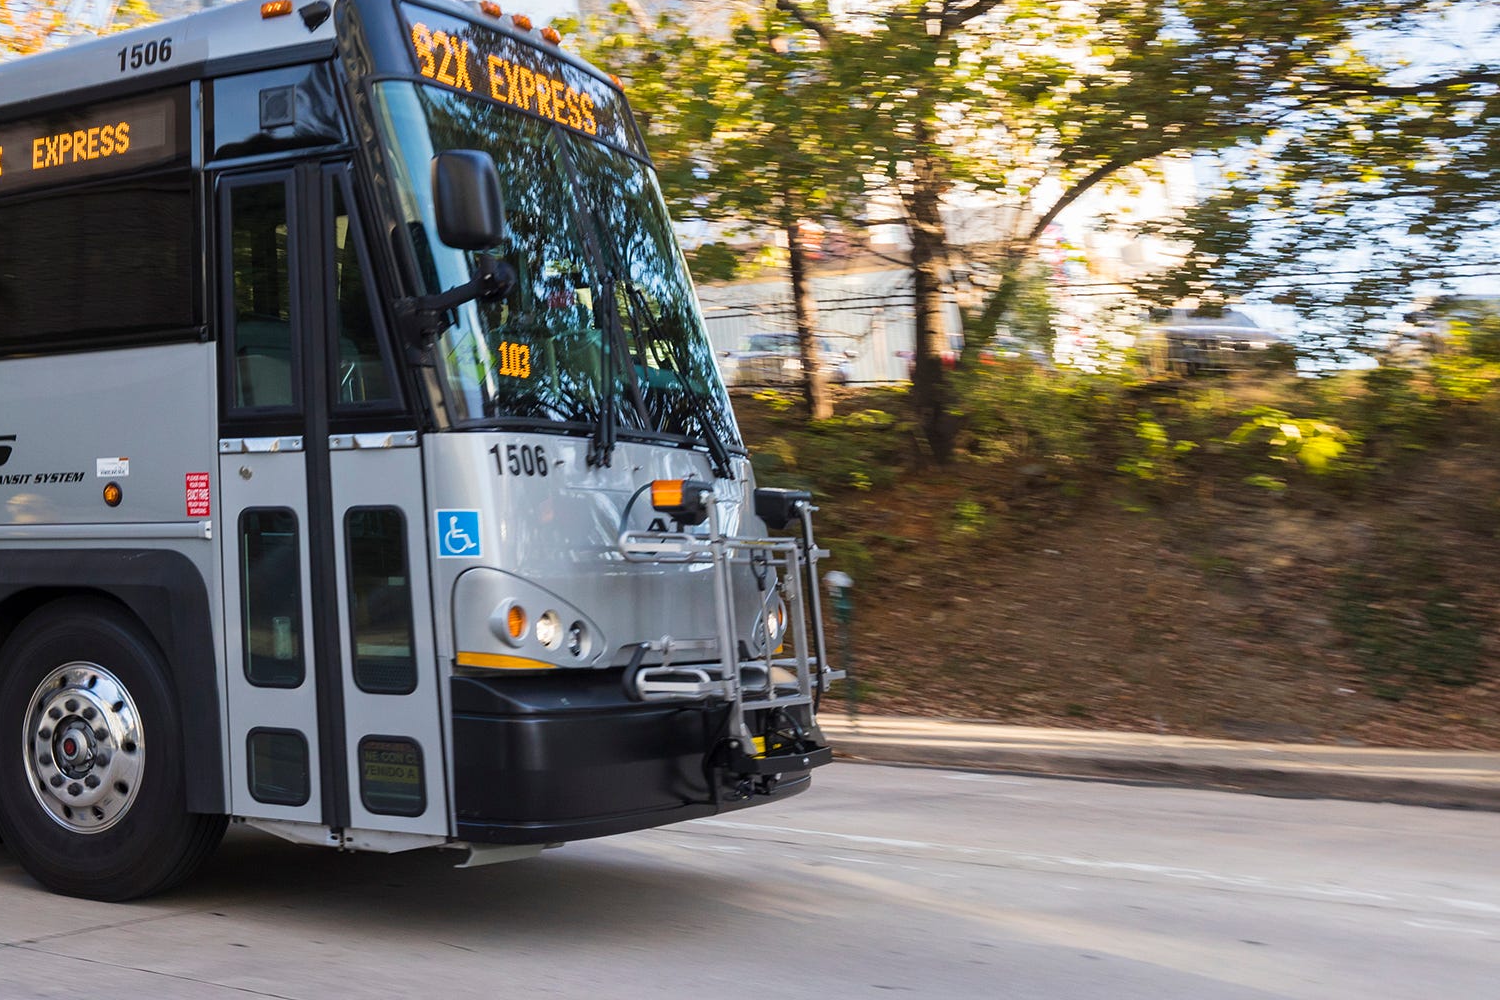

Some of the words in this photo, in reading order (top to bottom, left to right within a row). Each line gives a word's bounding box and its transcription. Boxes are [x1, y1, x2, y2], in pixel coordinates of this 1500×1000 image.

[117, 37, 173, 72] 1506
[412, 22, 473, 93] 82X
[487, 54, 597, 136] EXPRESS
[32, 121, 131, 170] EXPRESS
[499, 341, 531, 379] 103
[34, 471, 86, 484] SYSTEM
[489, 443, 548, 477] 1506
